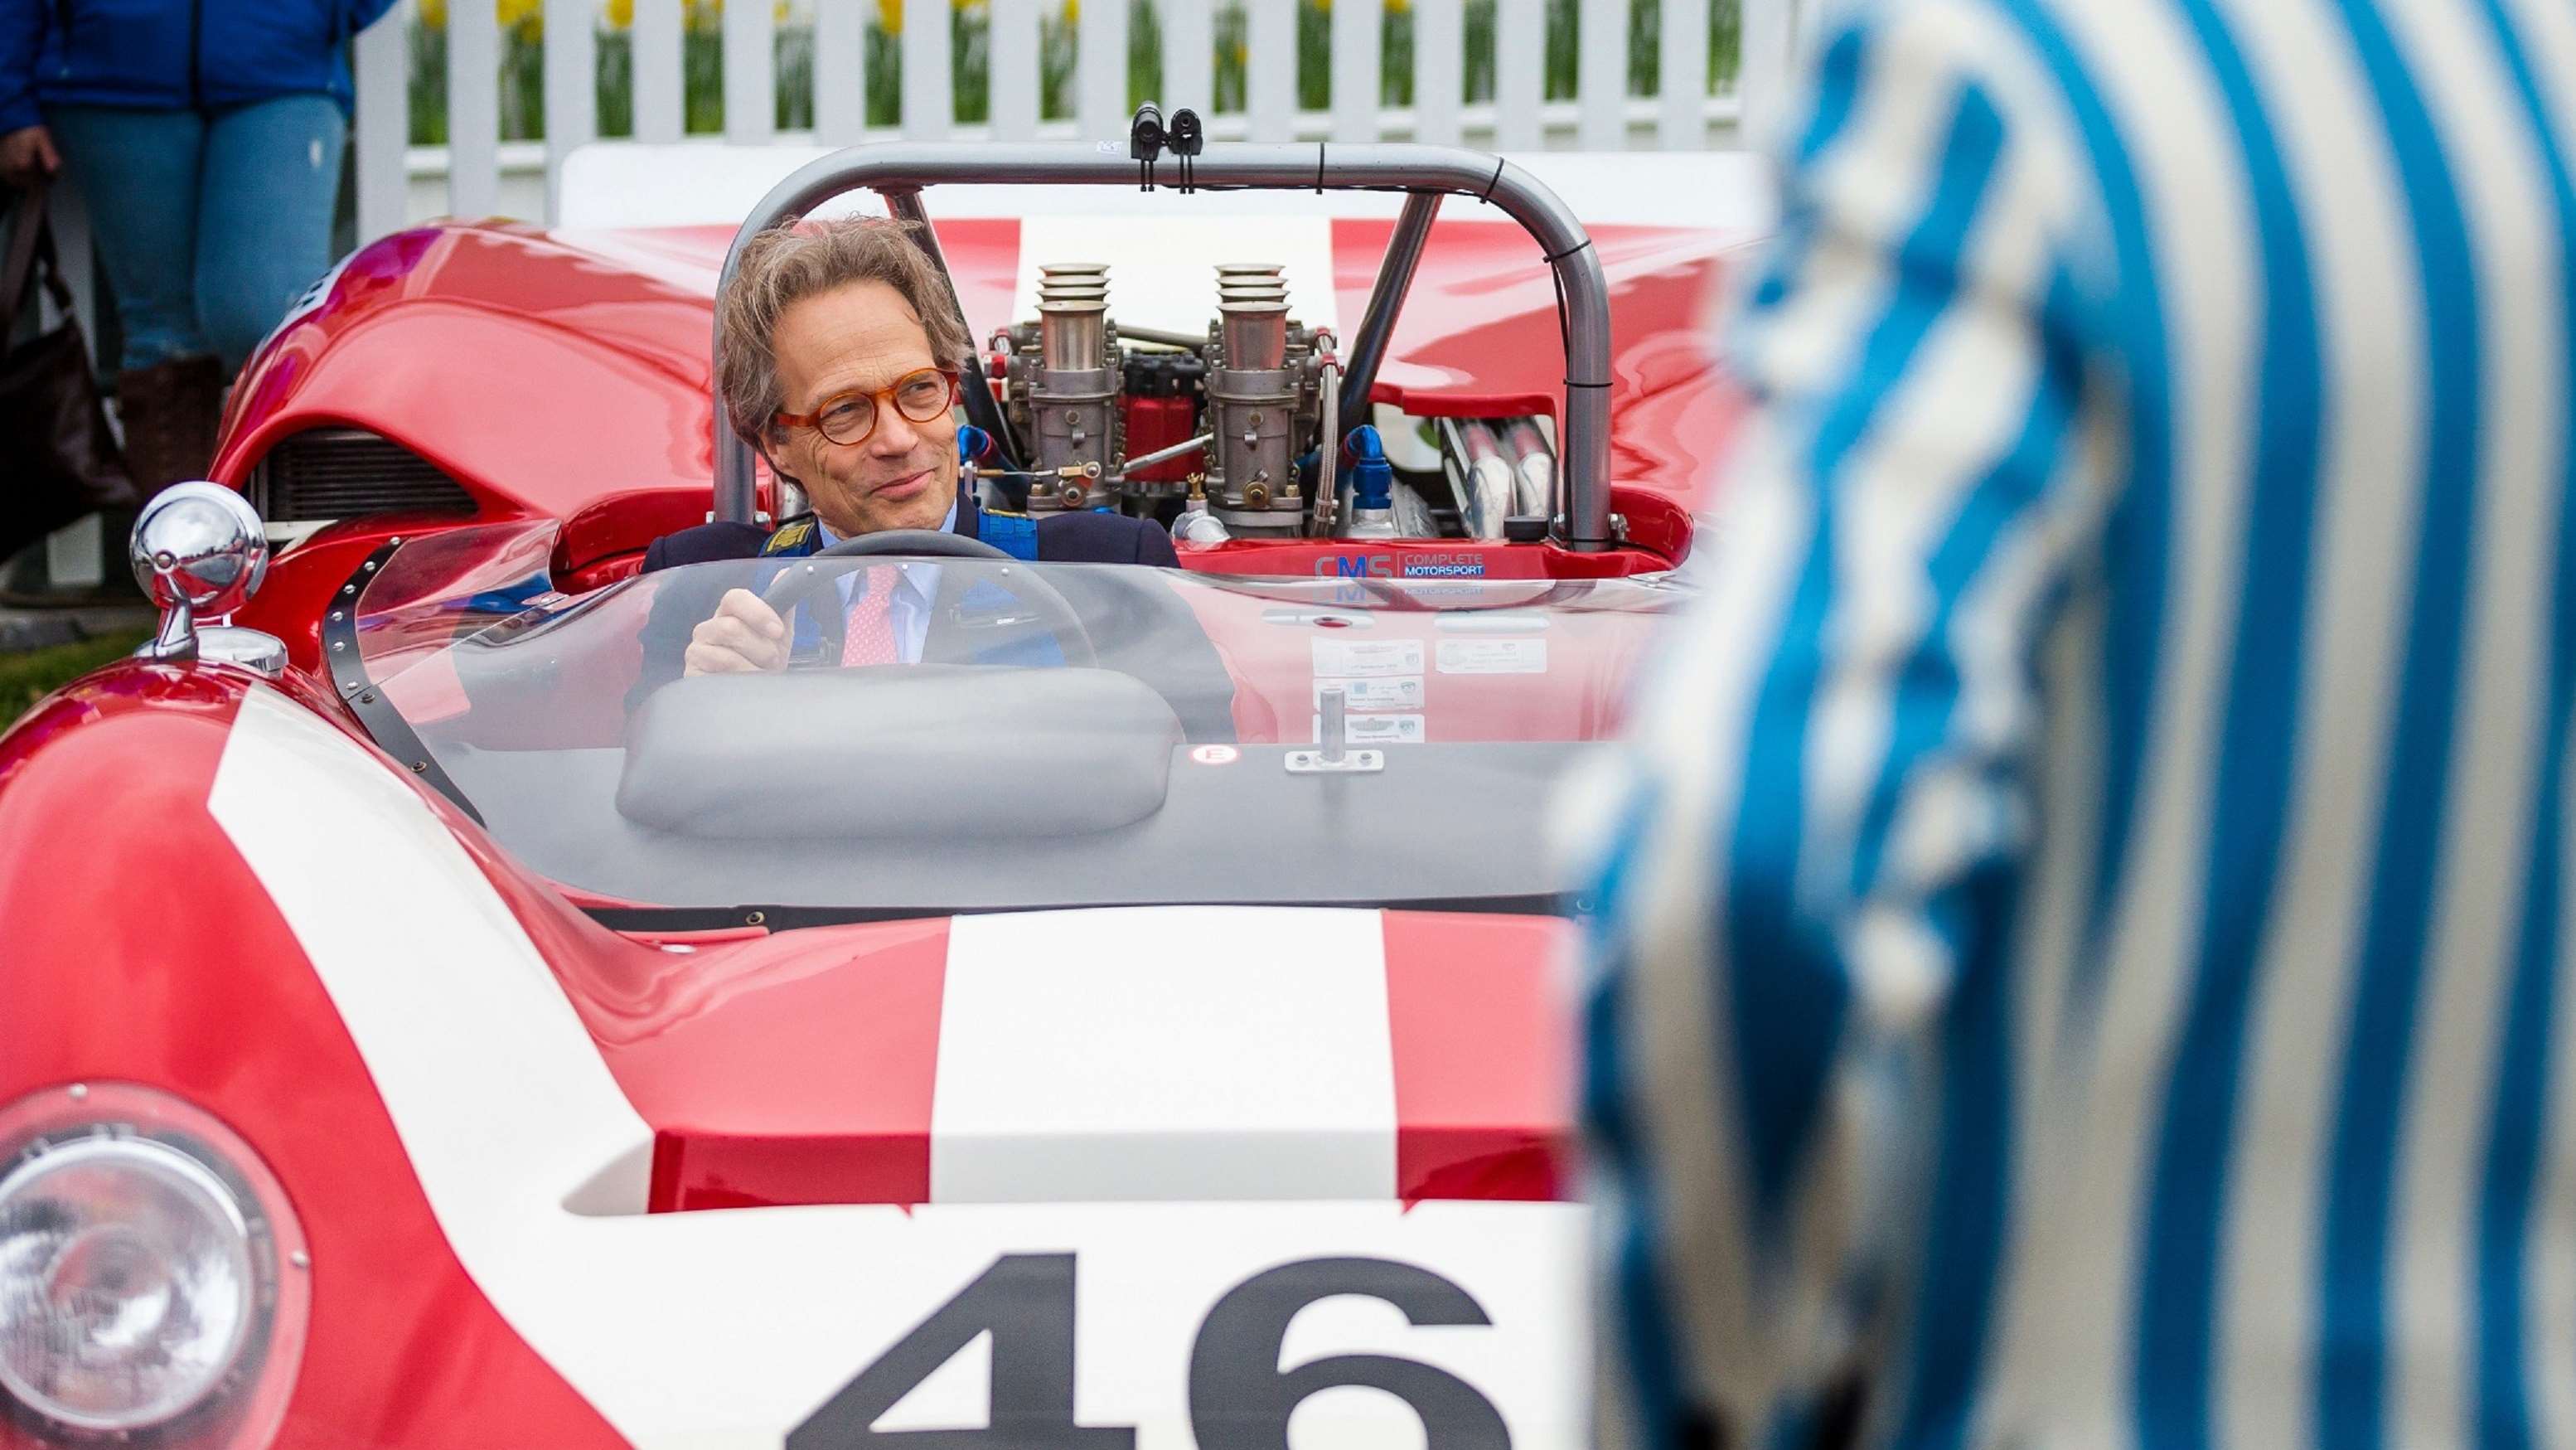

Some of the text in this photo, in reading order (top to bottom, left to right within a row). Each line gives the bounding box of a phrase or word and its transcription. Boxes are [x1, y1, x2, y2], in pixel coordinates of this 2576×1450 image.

[1405, 554, 1484, 565] COMPLETE
[1315, 555, 1393, 580] CMS
[1405, 565, 1484, 575] MOTORSPORT
[1205, 749, 1227, 759] E
[785, 1250, 1512, 1450] 46
